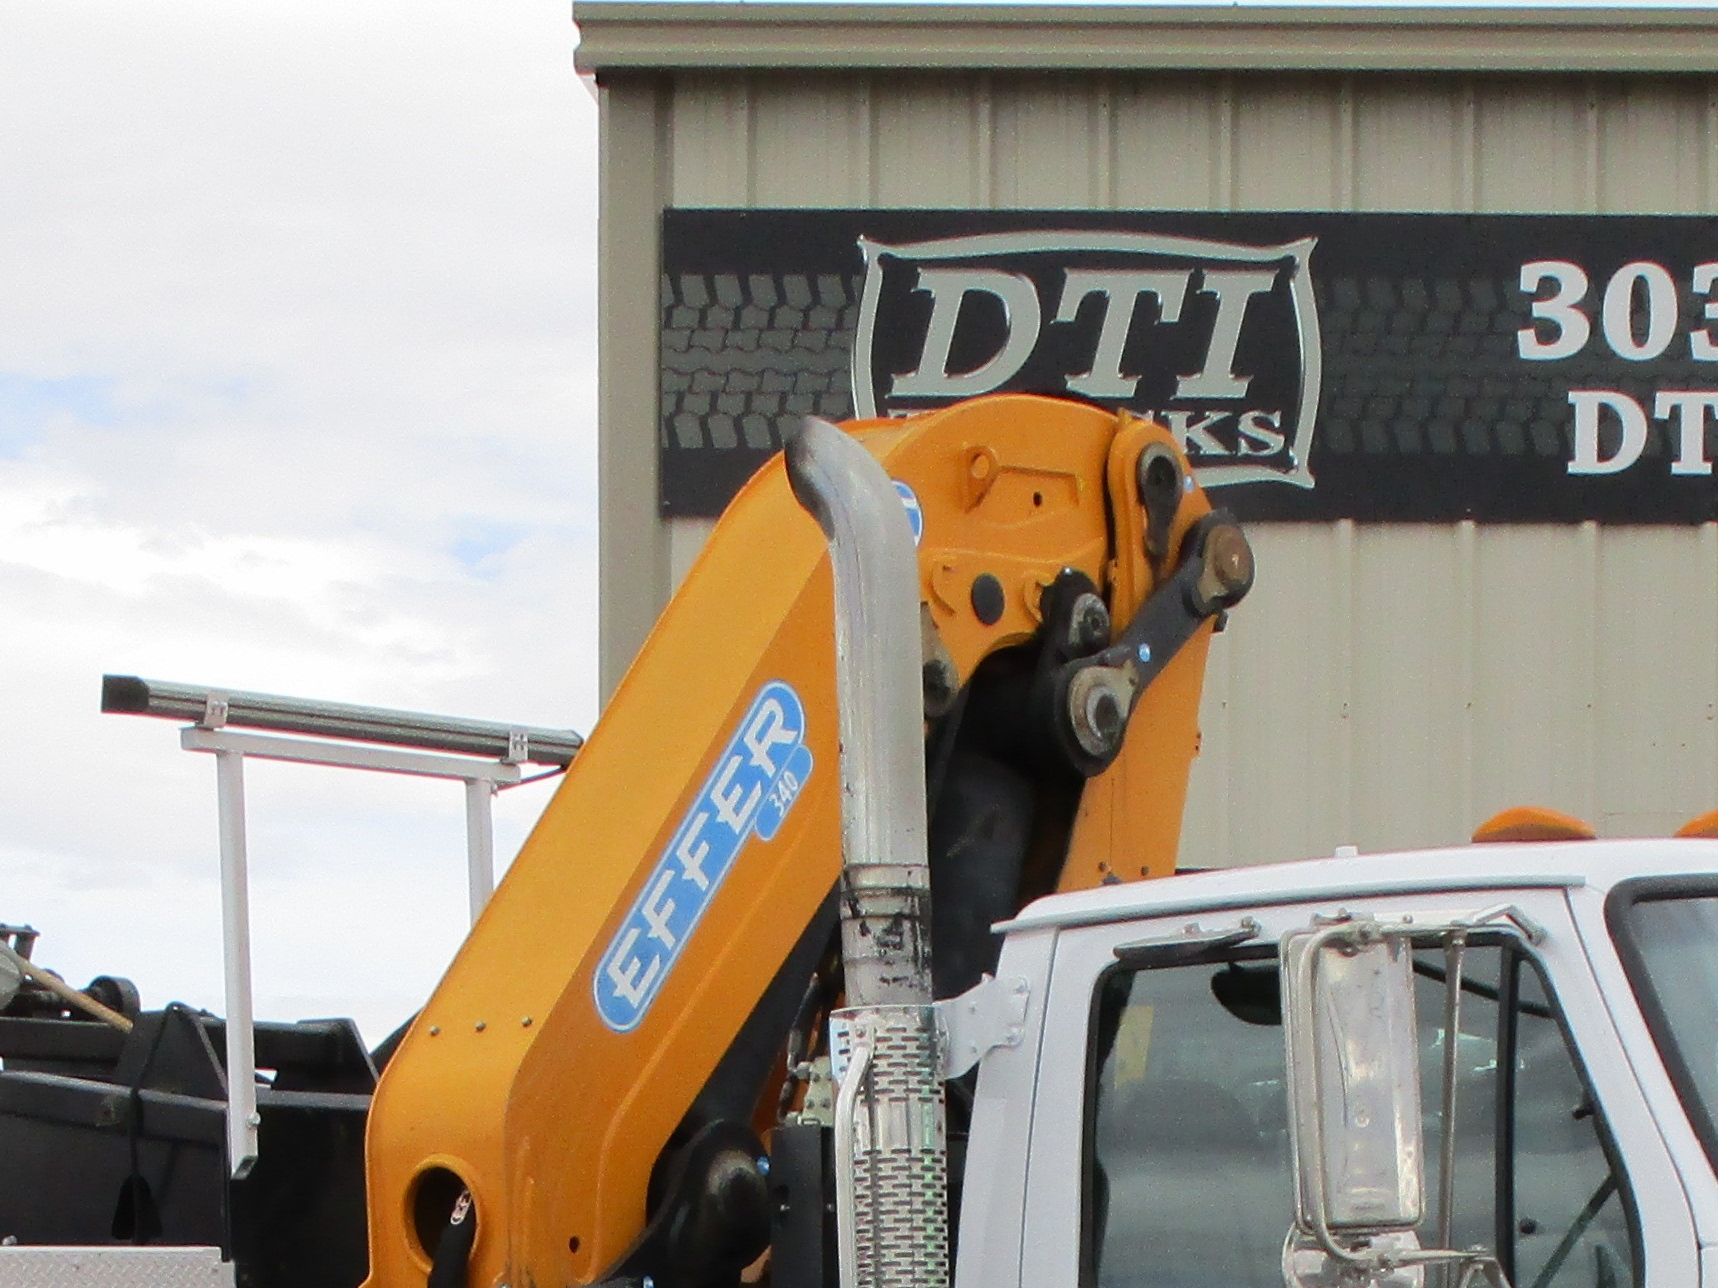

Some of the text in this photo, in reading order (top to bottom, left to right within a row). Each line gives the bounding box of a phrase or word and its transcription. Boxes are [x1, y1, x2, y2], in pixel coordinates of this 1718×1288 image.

[885, 267, 1280, 399] DTI
[606, 698, 798, 1008] EFFER
[768, 770, 800, 818] 340
